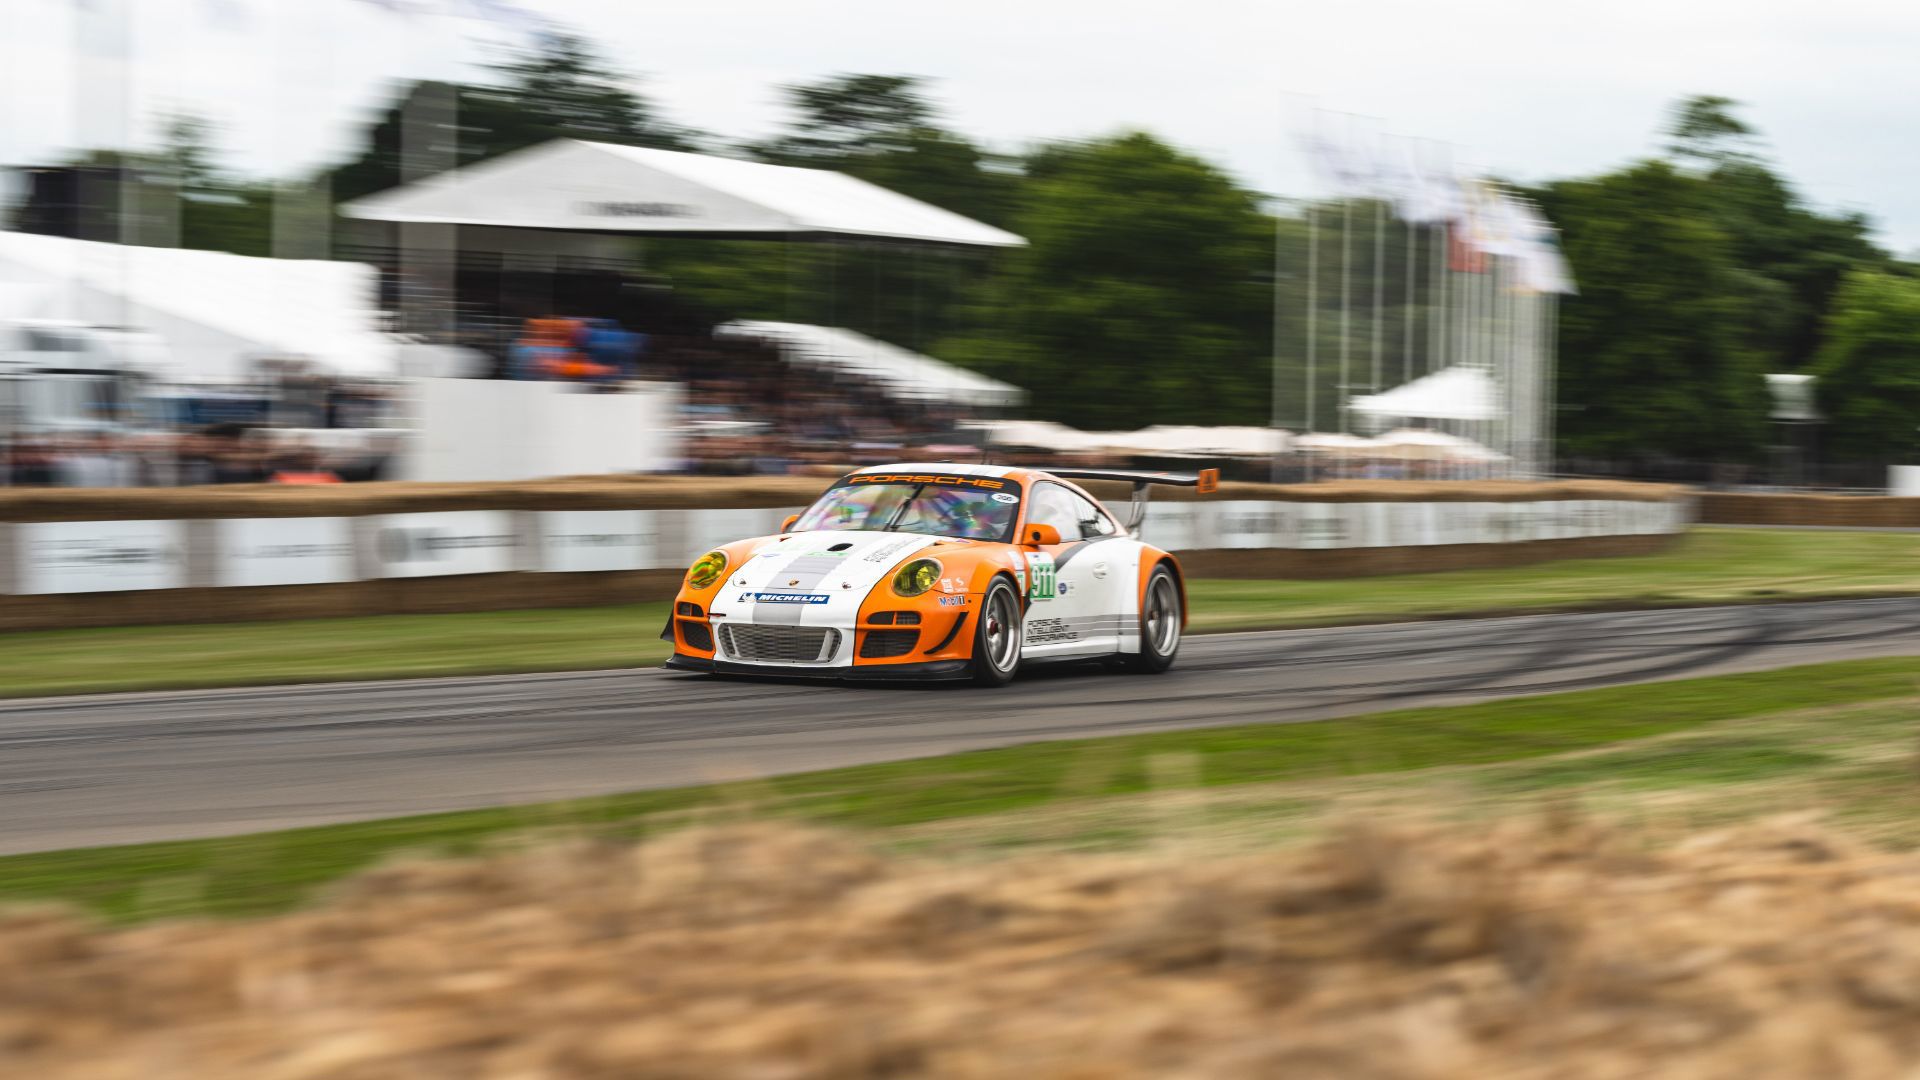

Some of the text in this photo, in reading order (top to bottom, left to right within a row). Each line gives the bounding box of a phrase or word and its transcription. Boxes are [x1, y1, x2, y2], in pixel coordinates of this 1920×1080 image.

[849, 475, 1005, 489] PORSCHE
[1031, 564, 1055, 598] 911
[758, 594, 827, 602] MICHELIN
[1027, 618, 1062, 628] PORSCHE
[1026, 632, 1078, 643] PERFORMANCE
